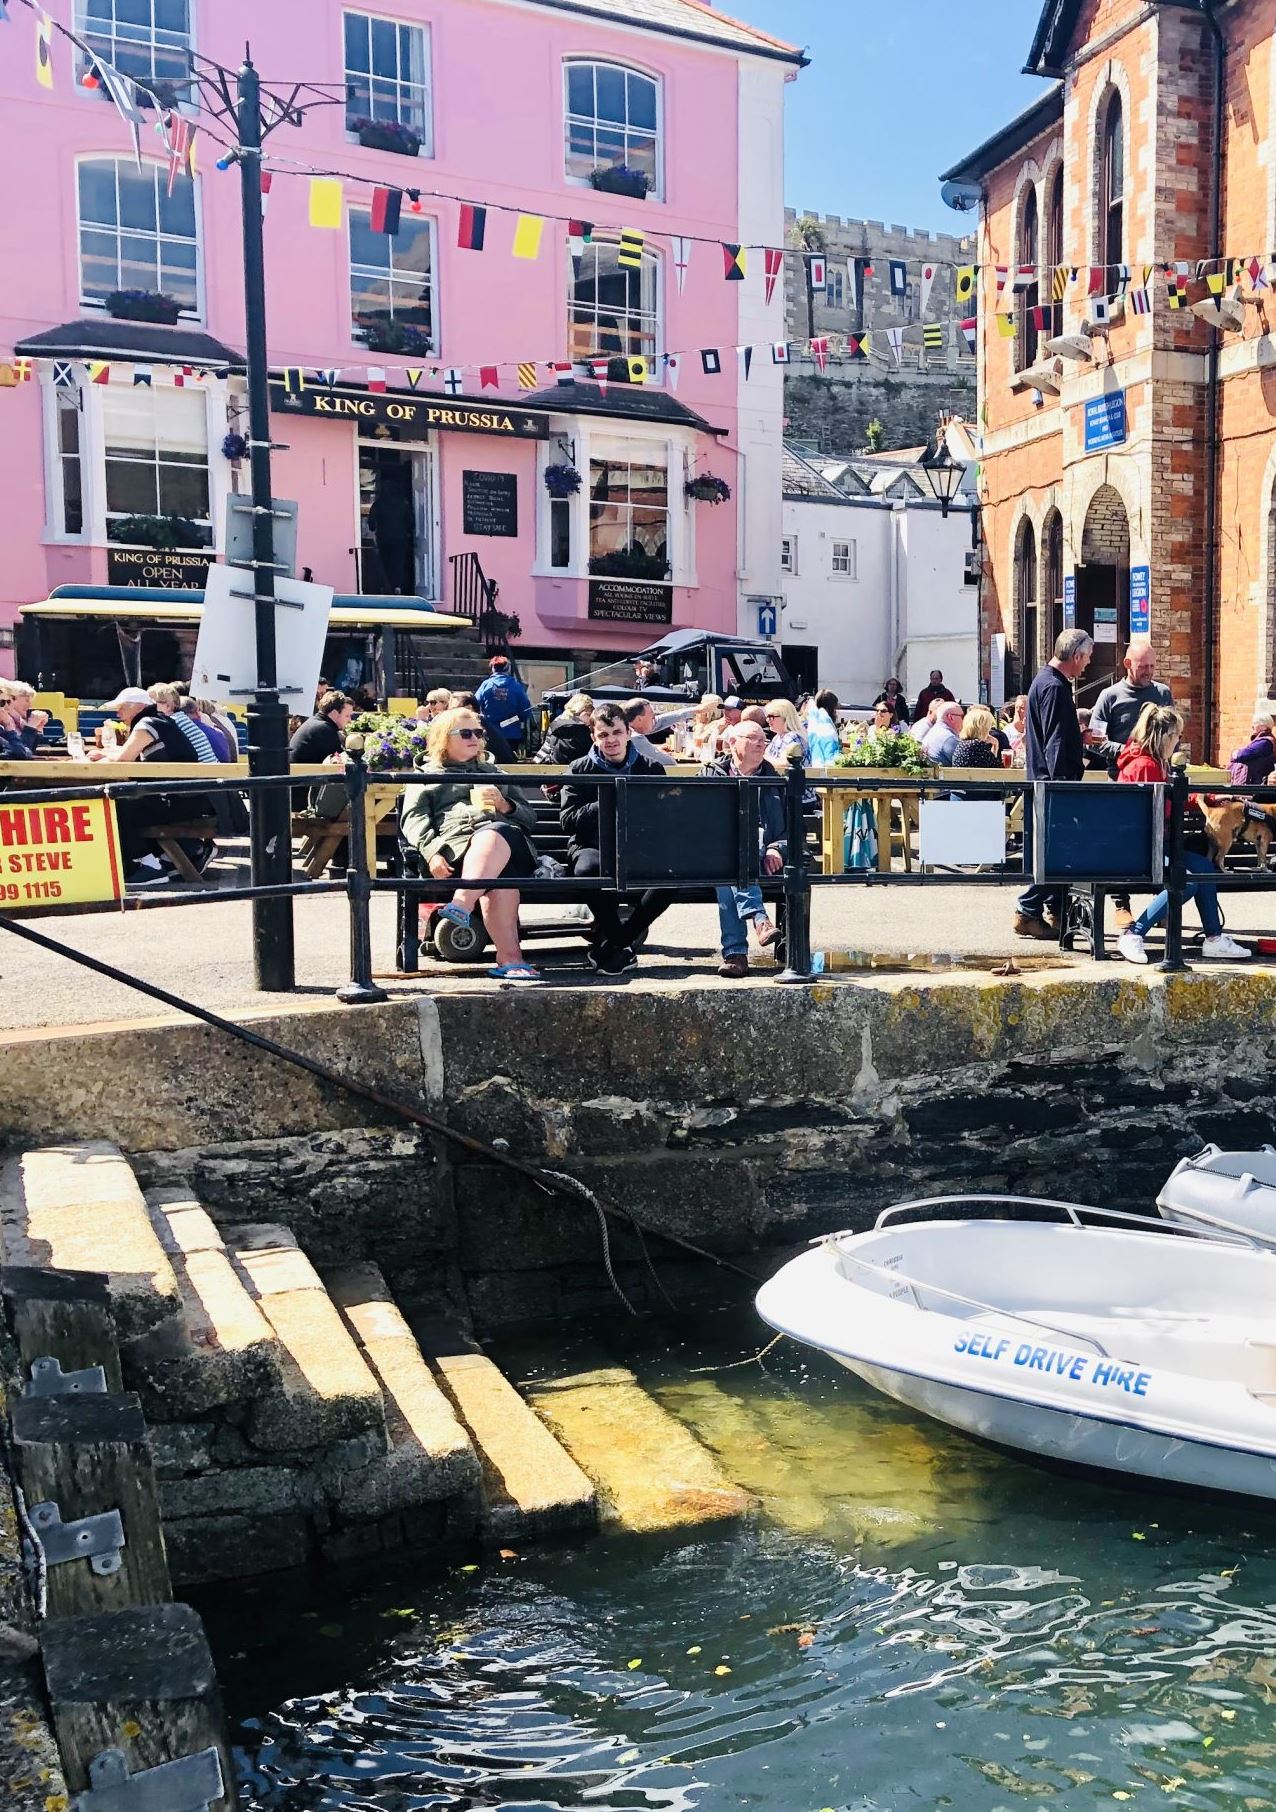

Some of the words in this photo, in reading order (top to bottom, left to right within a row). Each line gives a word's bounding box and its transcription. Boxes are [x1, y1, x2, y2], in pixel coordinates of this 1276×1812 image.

[313, 395, 376, 415] KING
[386, 404, 416, 420] OF
[426, 407, 515, 430] PRUSSIA
[114, 552, 143, 563] KING
[146, 554, 161, 564] OF
[165, 556, 209, 567] PRUSSIA
[142, 566, 183, 579] OPEN
[598, 584, 664, 595] ACCOMMODATION
[593, 609, 642, 619] SPECTACULAR
[644, 613, 667, 621] VIEWS
[0, 806, 94, 846] HIRE
[8, 851, 73, 873] STEVE
[23, 881, 62, 899] 1115
[953, 1331, 1011, 1361] SELF
[1013, 1343, 1089, 1380] DRIVE
[1092, 1362, 1153, 1397] HIRE
